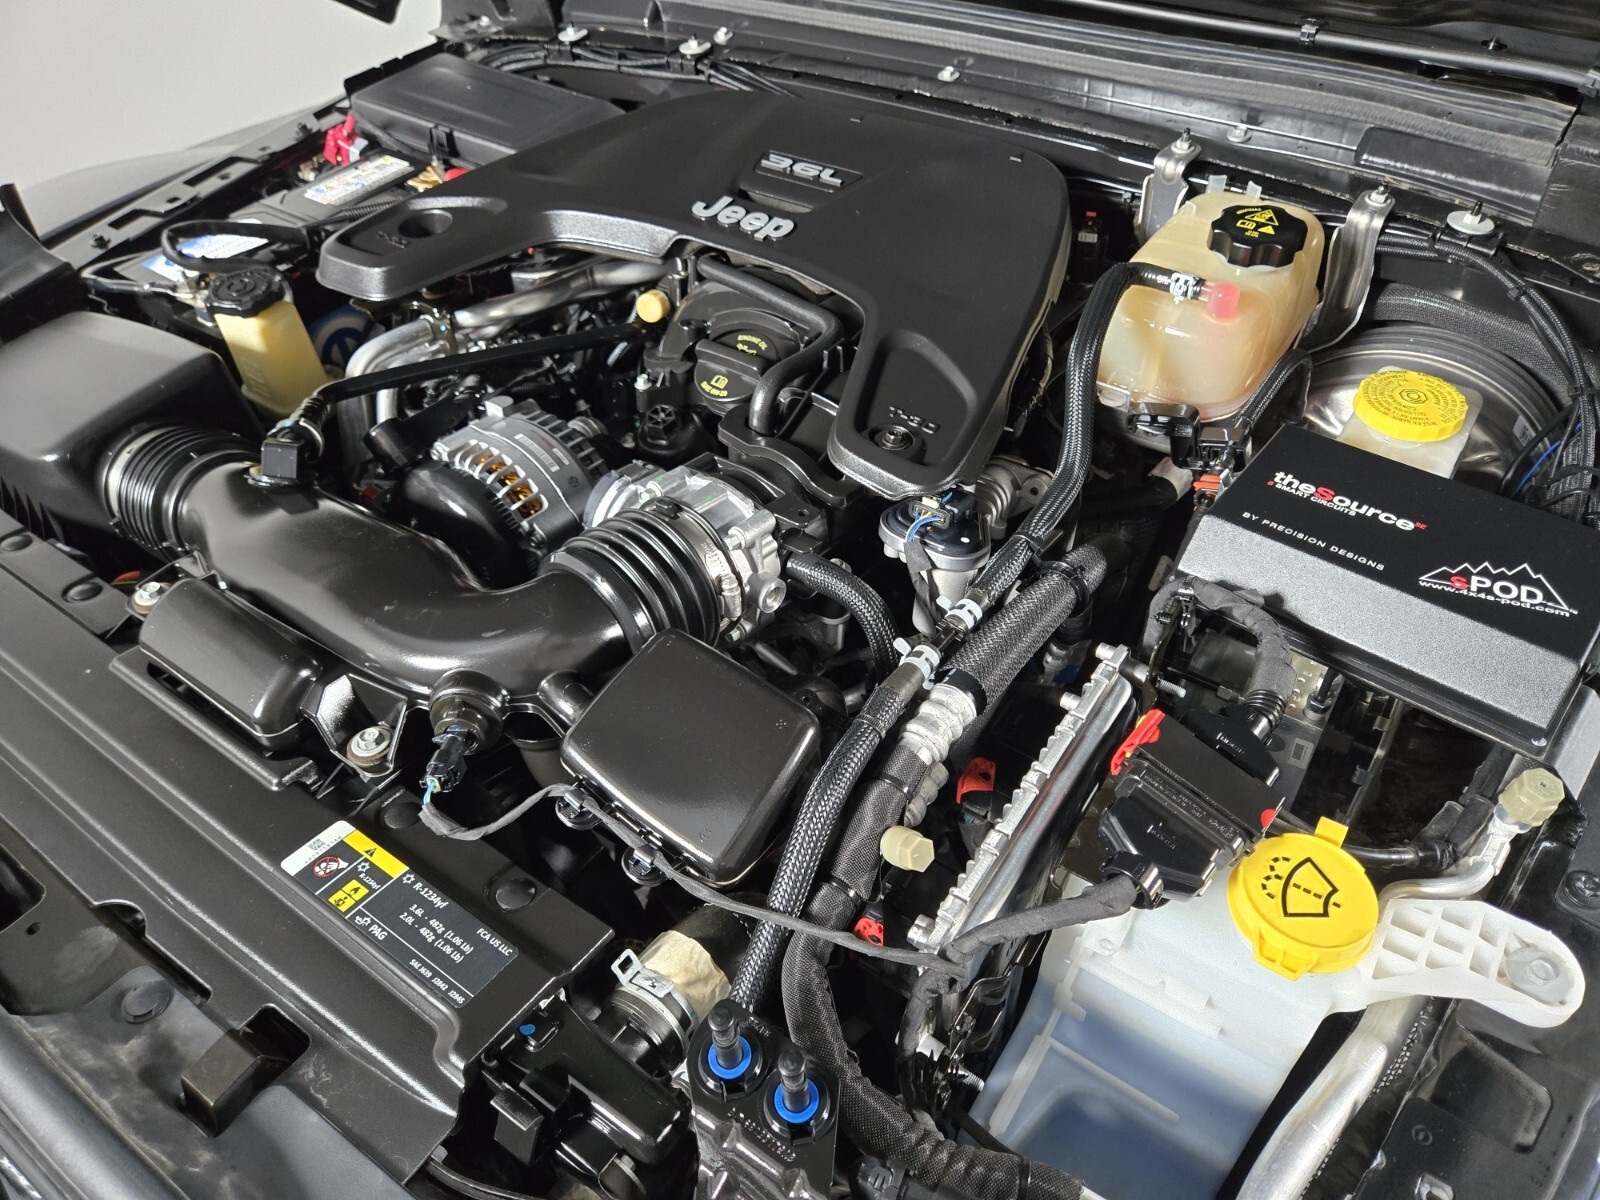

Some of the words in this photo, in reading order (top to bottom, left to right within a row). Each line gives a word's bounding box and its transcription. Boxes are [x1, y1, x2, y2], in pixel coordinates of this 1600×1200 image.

[761, 153, 842, 187] 3.6L
[691, 195, 794, 242] Jeep
[1275, 482, 1310, 500] SMART
[1310, 495, 1357, 517] CIRCUITS
[1242, 511, 1259, 522] BY
[1261, 518, 1327, 548] PRECISION
[1330, 545, 1385, 571] DESIGNS
[359, 873, 382, 890] R-1234yf
[413, 882, 449, 909] R-1234yf
[369, 925, 388, 941] PAG
[399, 912, 414, 926] 2.0L
[419, 926, 436, 943] 482g
[434, 938, 453, 955] (1.06
[451, 950, 465, 963] Lb)
[409, 903, 423, 917] 3.6L
[429, 918, 446, 935] 482g
[443, 930, 463, 946] (1.06
[460, 942, 474, 955] Lb)
[476, 928, 491, 941] FCA
[490, 939, 502, 949] US
[498, 943, 513, 956] LLC
[409, 958, 421, 970] SAE
